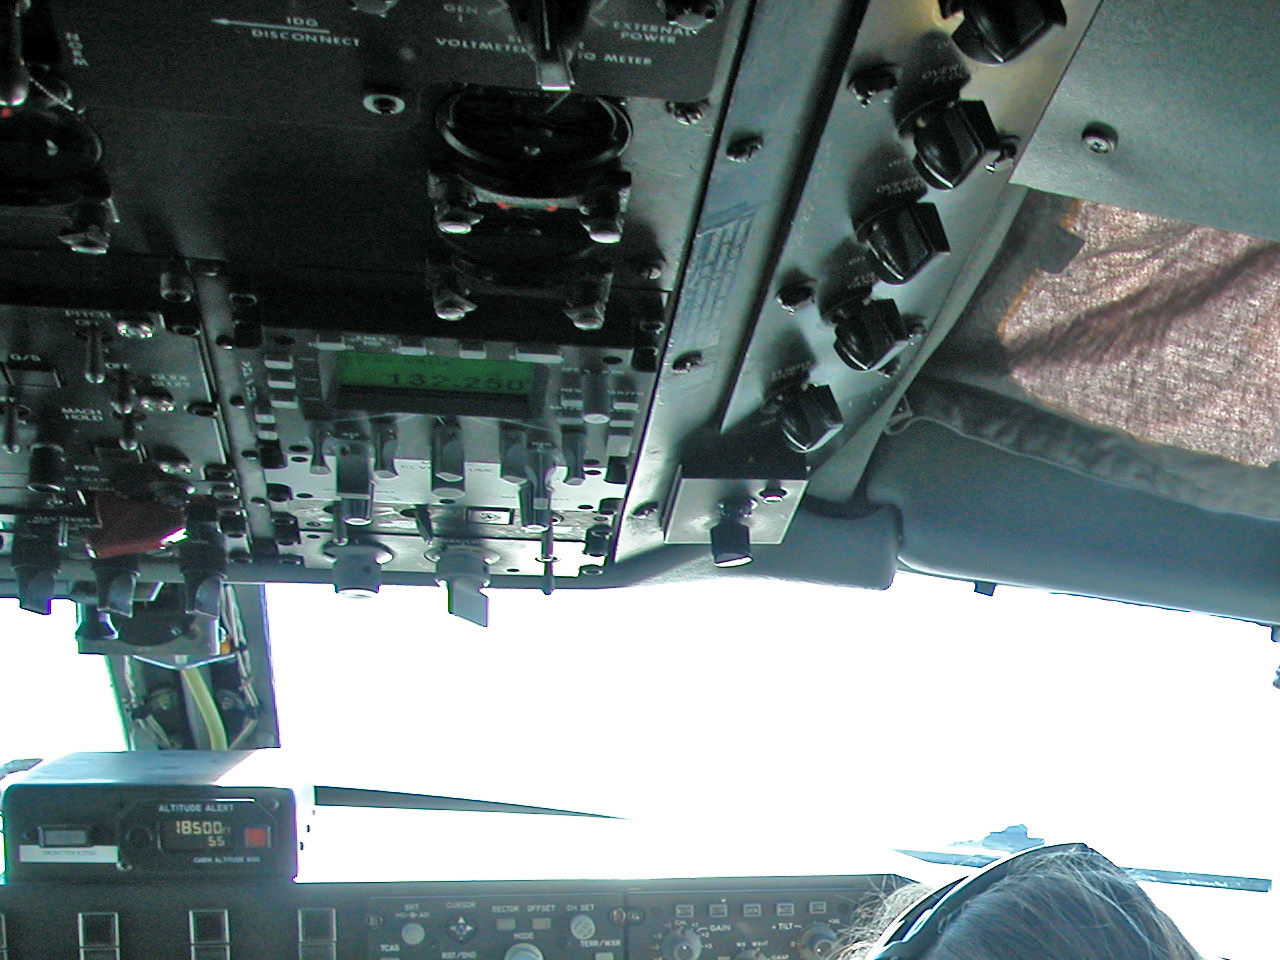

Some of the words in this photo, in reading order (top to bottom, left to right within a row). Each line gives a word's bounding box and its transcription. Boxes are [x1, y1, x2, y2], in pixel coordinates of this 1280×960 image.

[286, 16, 319, 28] IDG
[613, 21, 694, 37] EXTERNAL
[251, 28, 360, 48] DISCONNECT
[620, 32, 677, 45] POWER
[604, 53, 653, 66] METER
[158, 803, 202, 813] ALTITUDE
[204, 803, 235, 813] ALERT
[175, 820, 223, 835] 18500
[445, 901, 477, 910] CURSOR
[491, 905, 520, 914] SECTOR
[526, 904, 556, 913] OFFSET
[579, 903, 595, 912] SET
[709, 924, 732, 933] GAIN
[778, 922, 794, 931] TILT
[513, 931, 535, 940] MODE
[380, 943, 401, 953] TCAS
